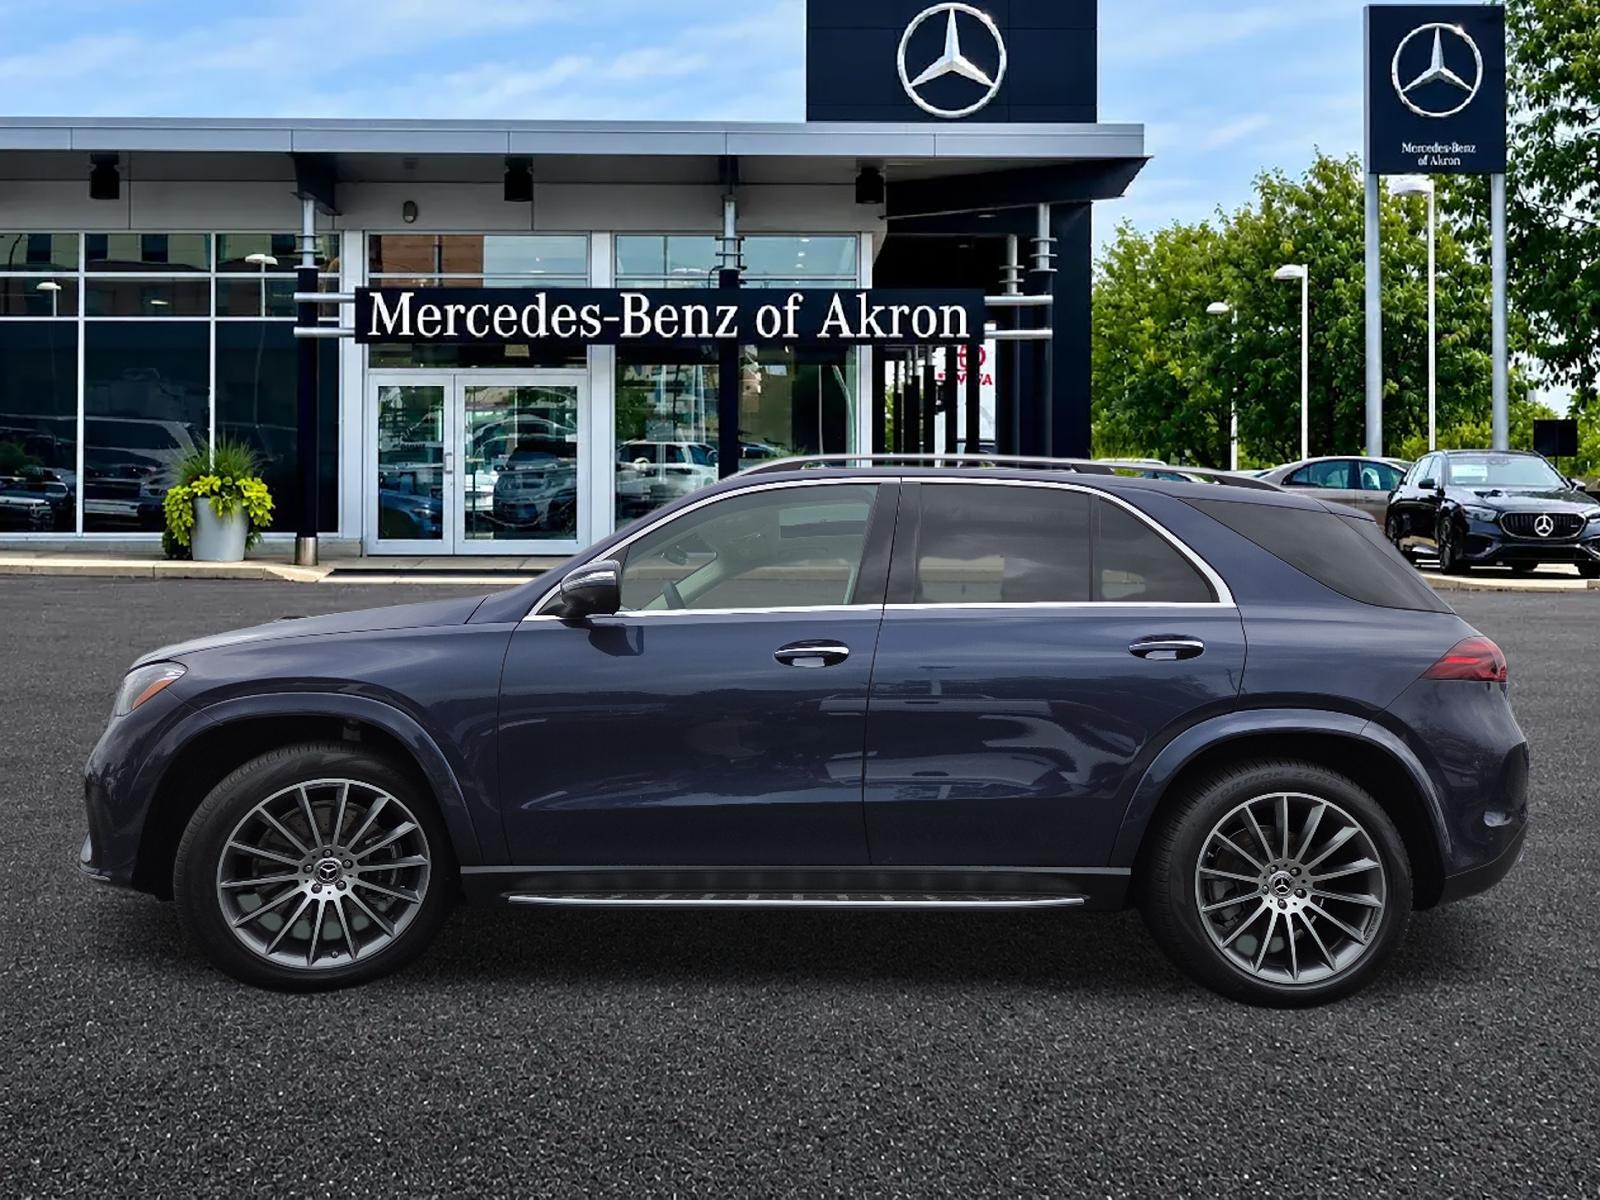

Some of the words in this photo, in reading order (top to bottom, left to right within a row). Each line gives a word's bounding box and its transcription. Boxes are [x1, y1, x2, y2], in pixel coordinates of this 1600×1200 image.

[1401, 142, 1477, 154] Mercedes-Benz
[1417, 155, 1428, 166] of
[1430, 155, 1461, 166] Akron
[367, 292, 738, 338] Mercedes-Benz
[756, 292, 804, 338] of
[816, 292, 970, 338] Akron
